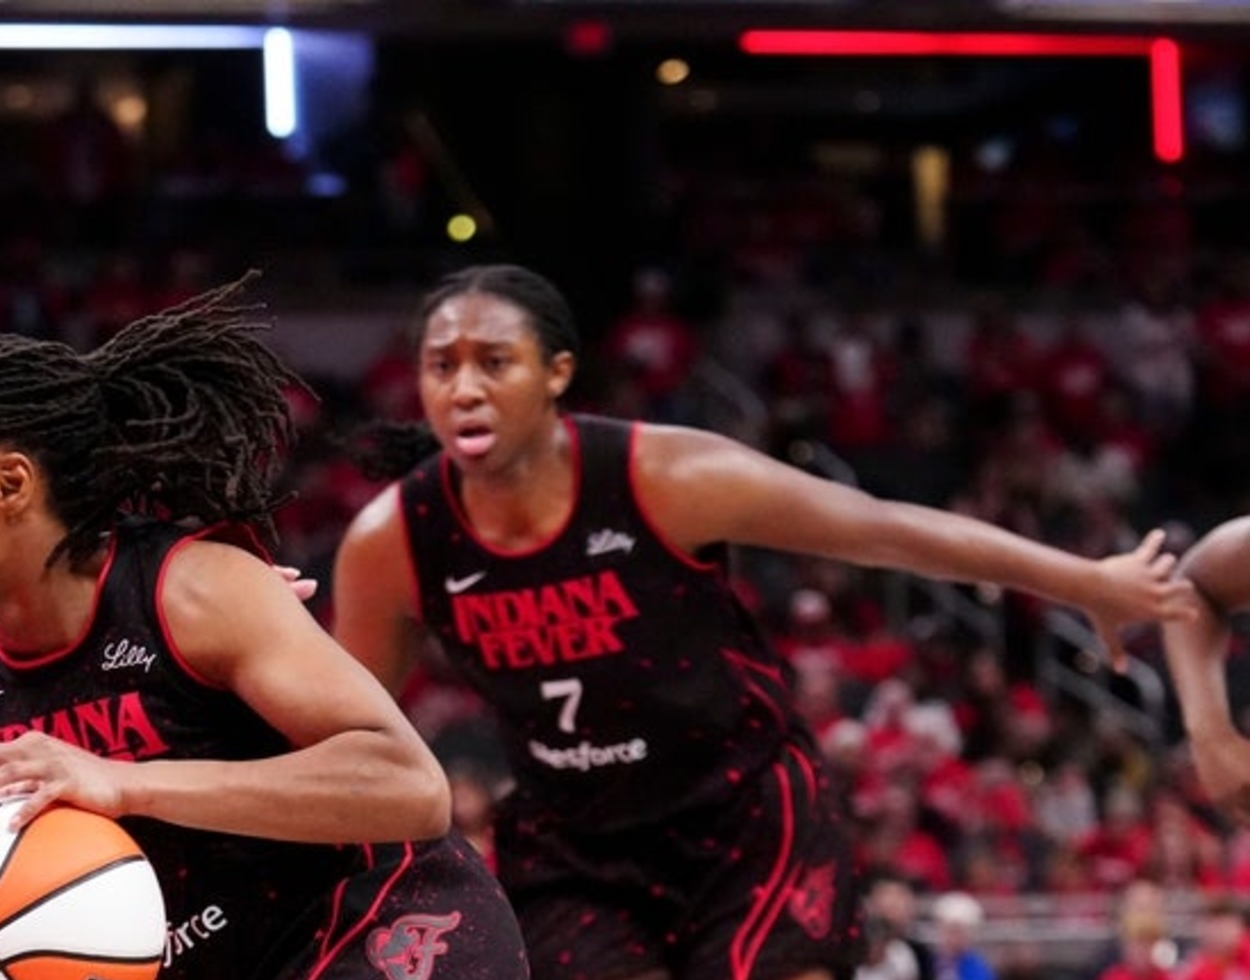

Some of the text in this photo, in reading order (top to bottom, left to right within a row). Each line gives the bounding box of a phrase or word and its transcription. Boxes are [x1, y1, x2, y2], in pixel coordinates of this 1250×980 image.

[452, 570, 640, 644] INDIANA
[101, 638, 157, 673] Lilly
[479, 613, 625, 670] FEVER
[540, 677, 583, 733] 7
